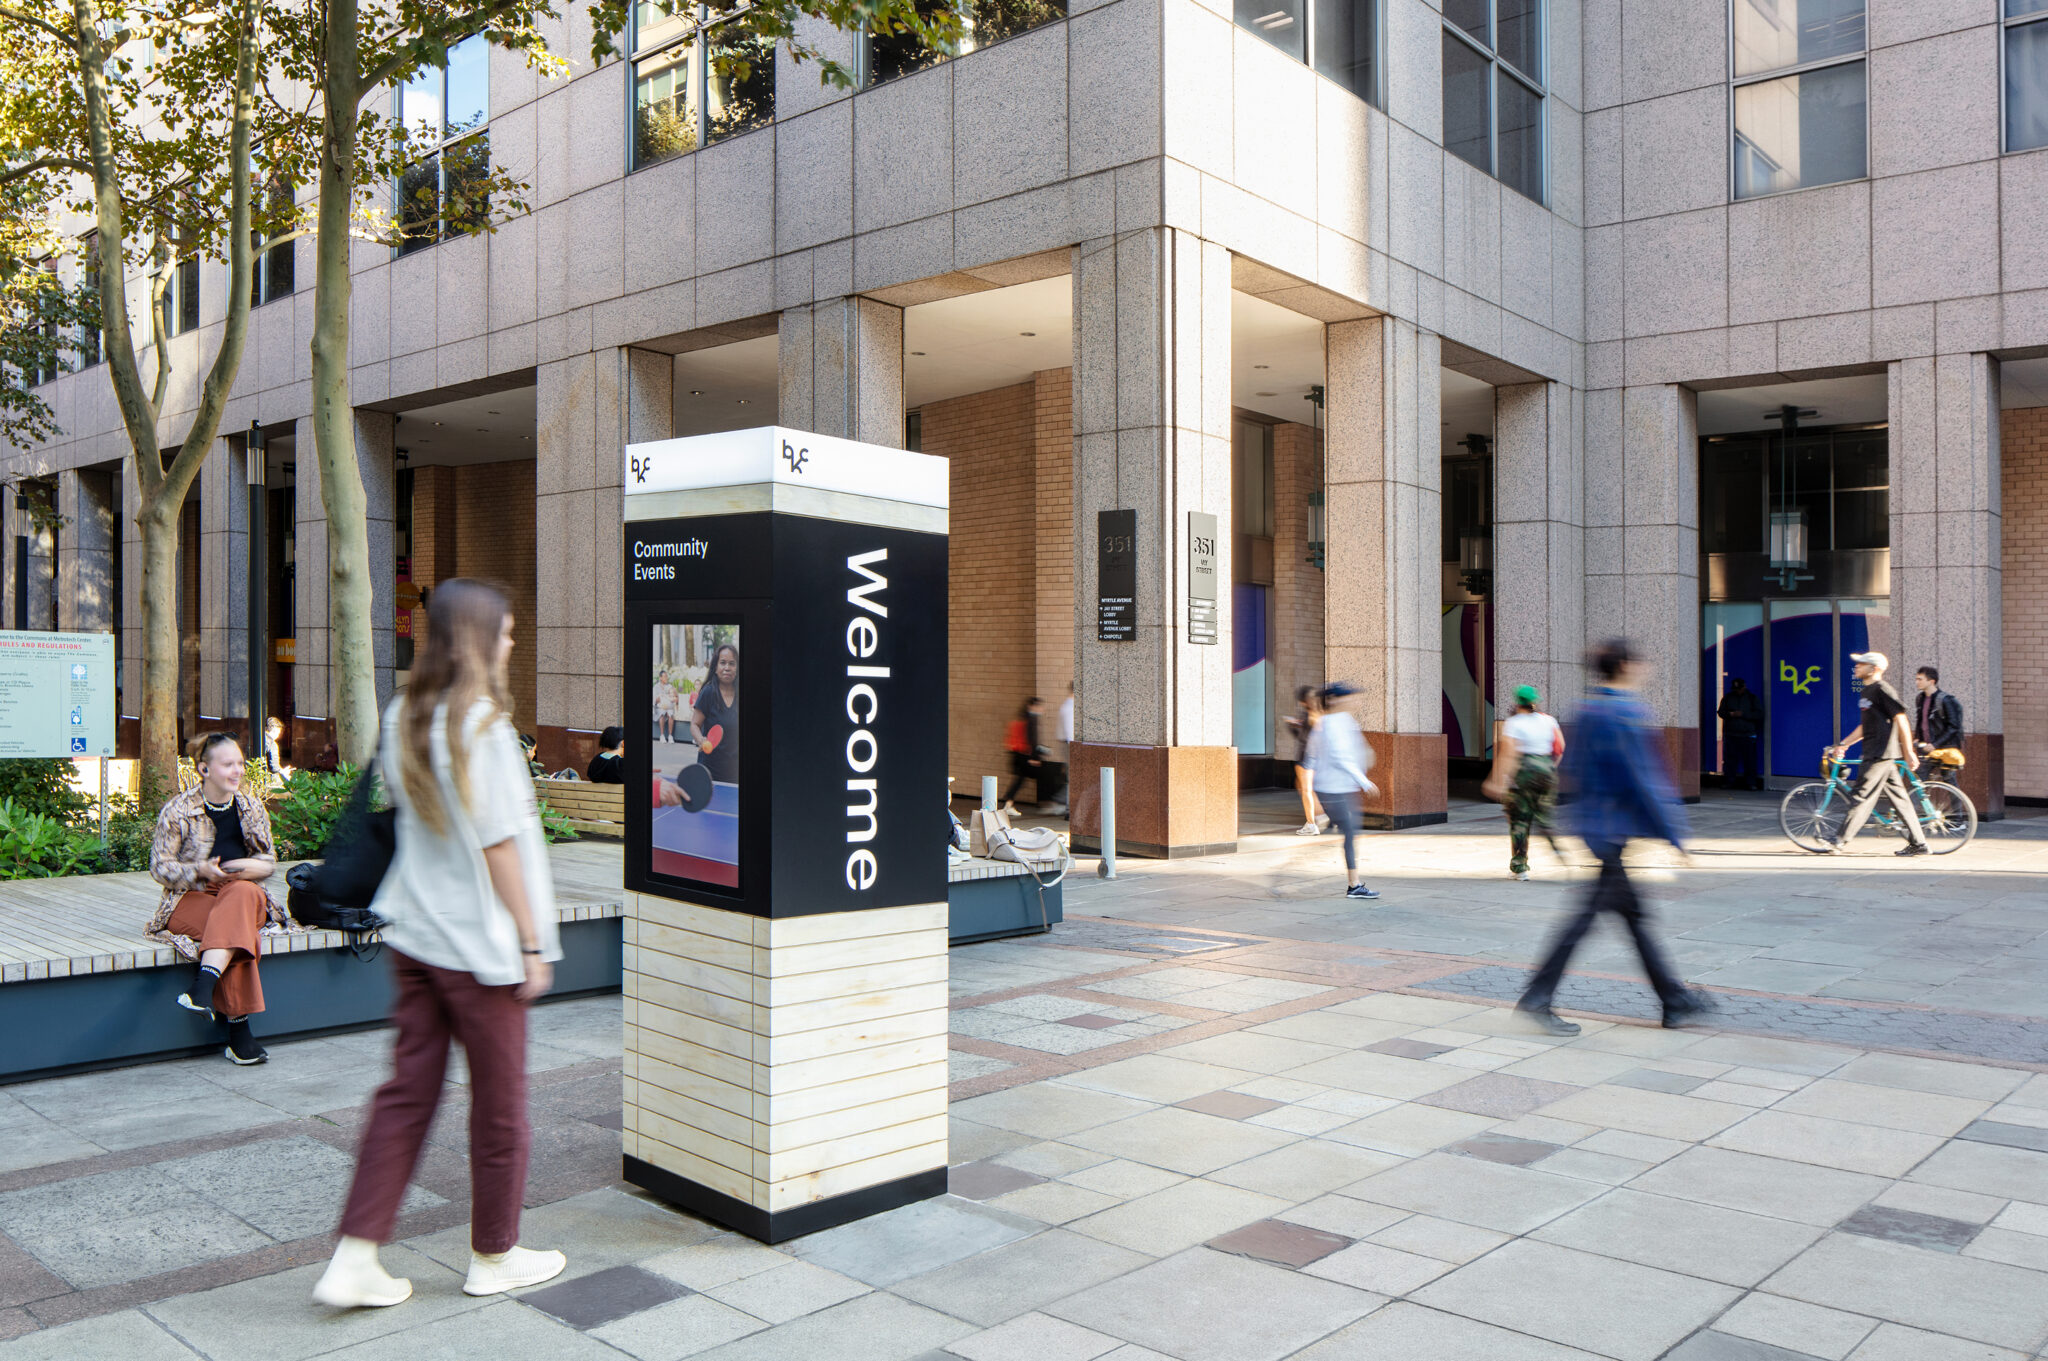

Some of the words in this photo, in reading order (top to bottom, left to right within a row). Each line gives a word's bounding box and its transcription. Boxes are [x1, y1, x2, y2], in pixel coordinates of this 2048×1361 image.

[634, 537, 708, 559] Community
[1104, 535, 1131, 553] 351
[1194, 536, 1214, 556] 351
[634, 563, 675, 581] Events
[37, 642, 82, 650] REGULATIONS
[846, 548, 891, 891] Welcome
